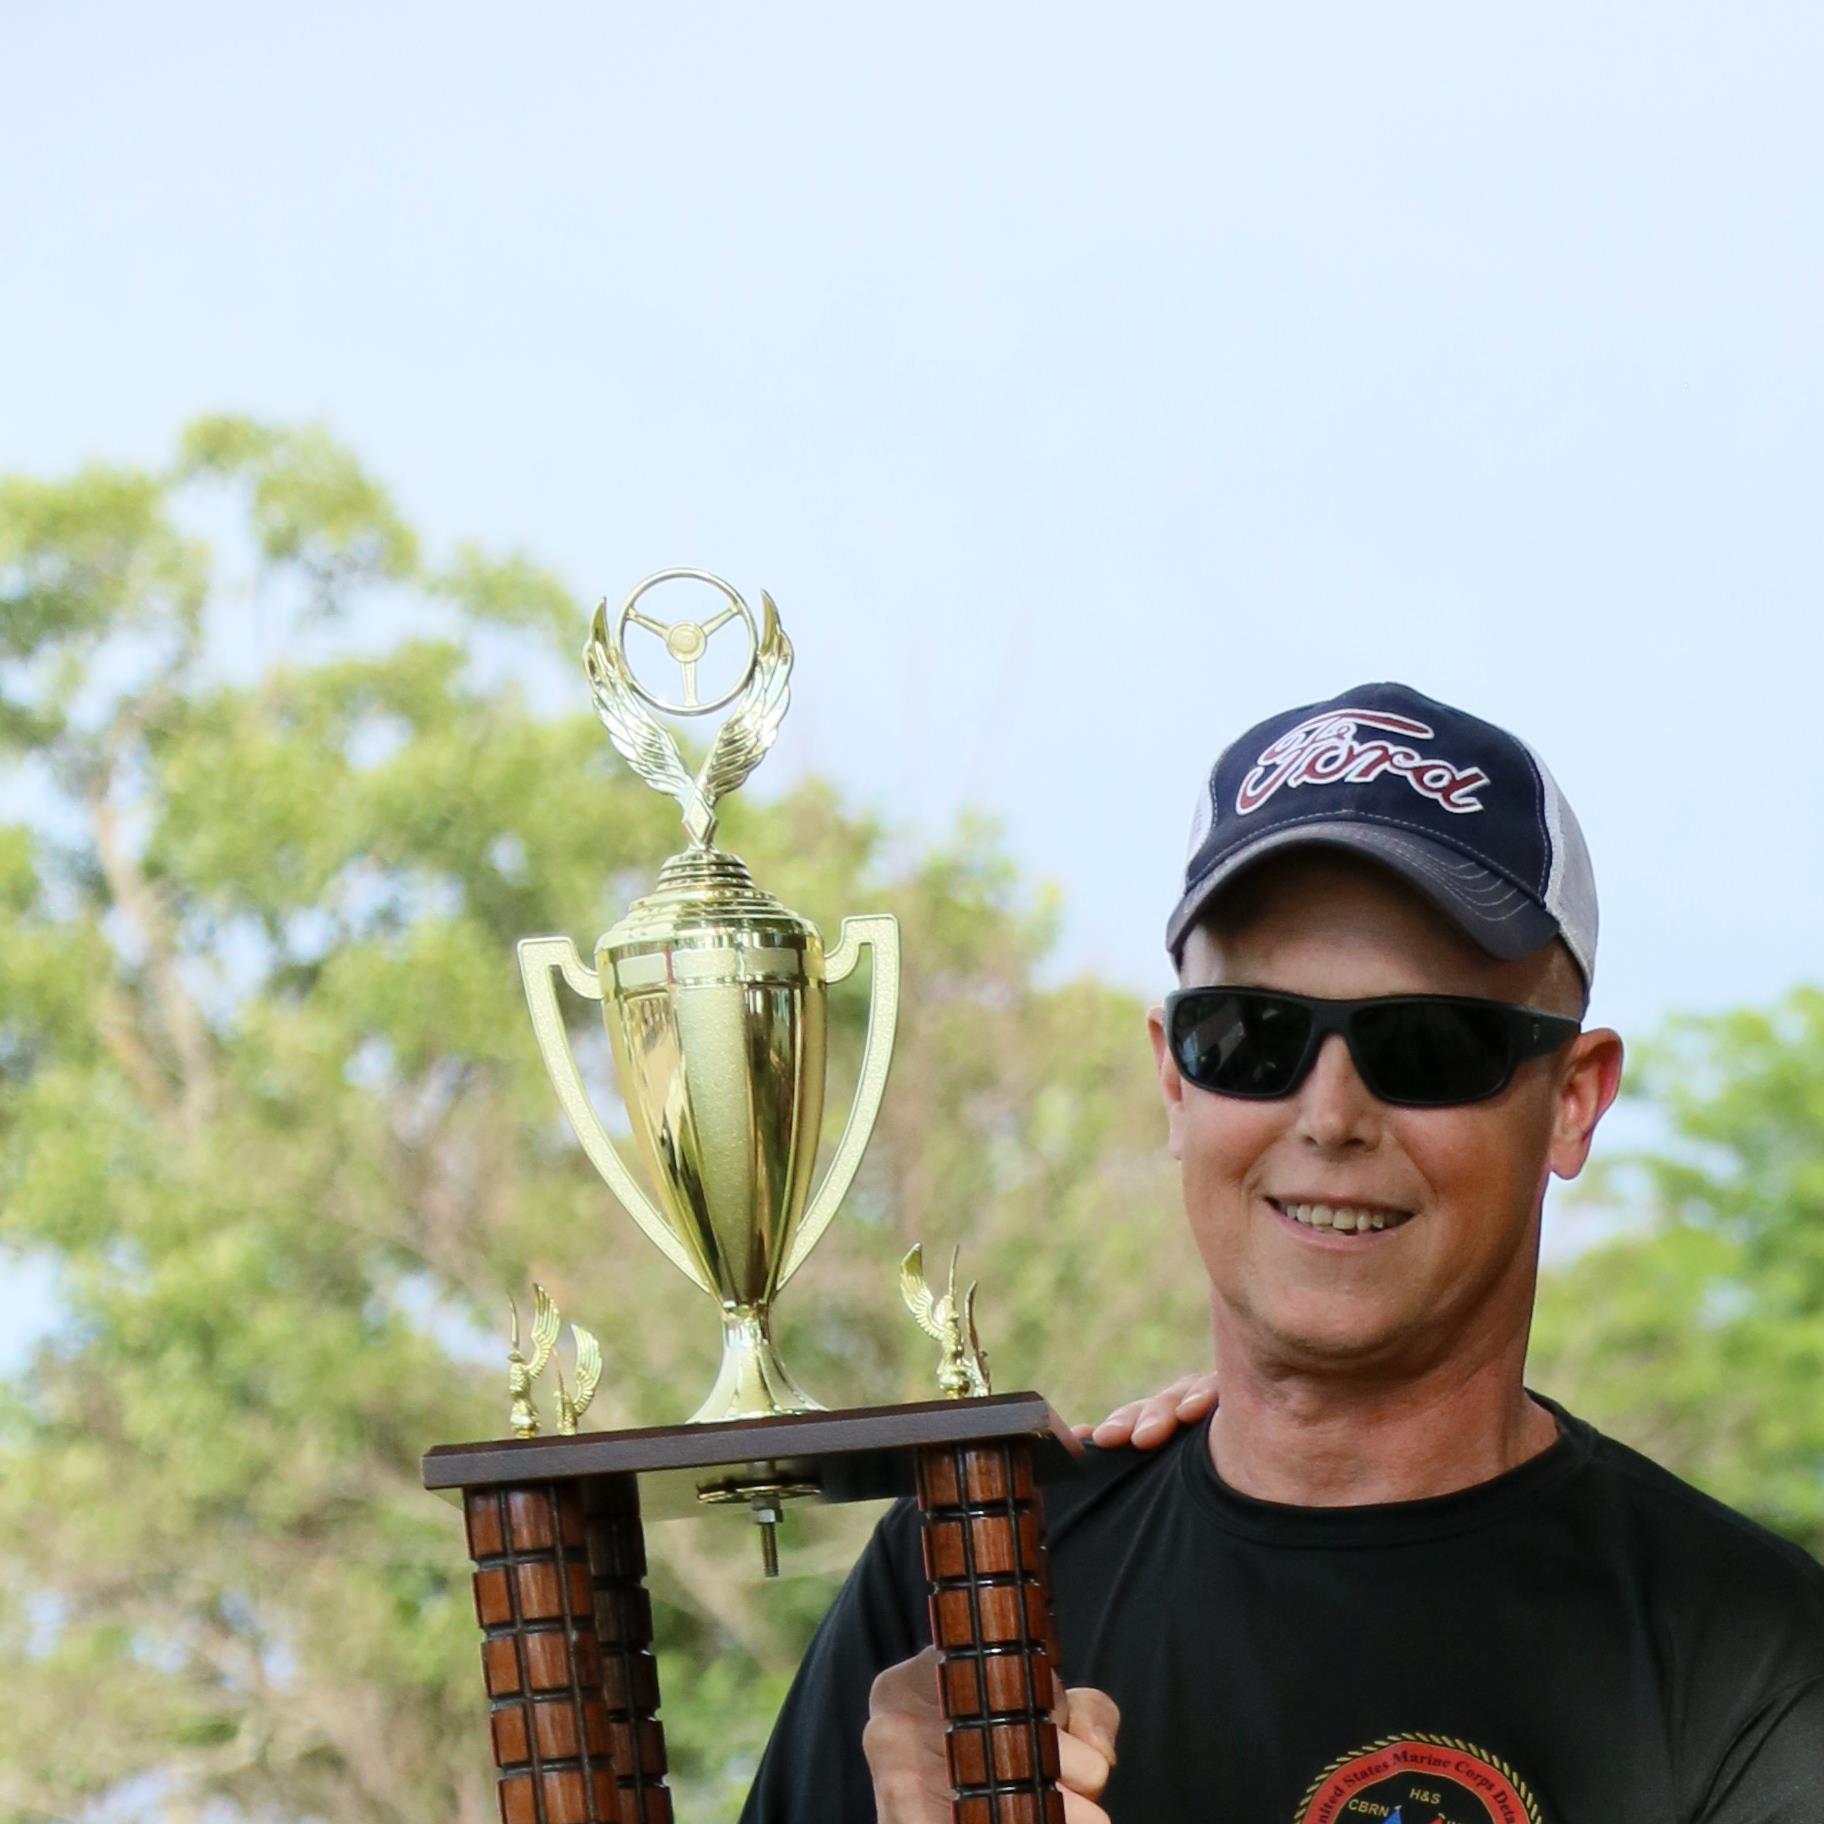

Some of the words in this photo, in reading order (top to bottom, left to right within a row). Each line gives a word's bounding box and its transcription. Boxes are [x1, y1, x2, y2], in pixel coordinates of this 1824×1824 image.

[1236, 709, 1490, 815] Ford
[1342, 1761, 1390, 1787] States
[1392, 1750, 1451, 1768] Marine
[1455, 1761, 1496, 1791] Corps
[1348, 1799, 1390, 1817] CBRN
[1408, 1788, 1441, 1804] H&S
